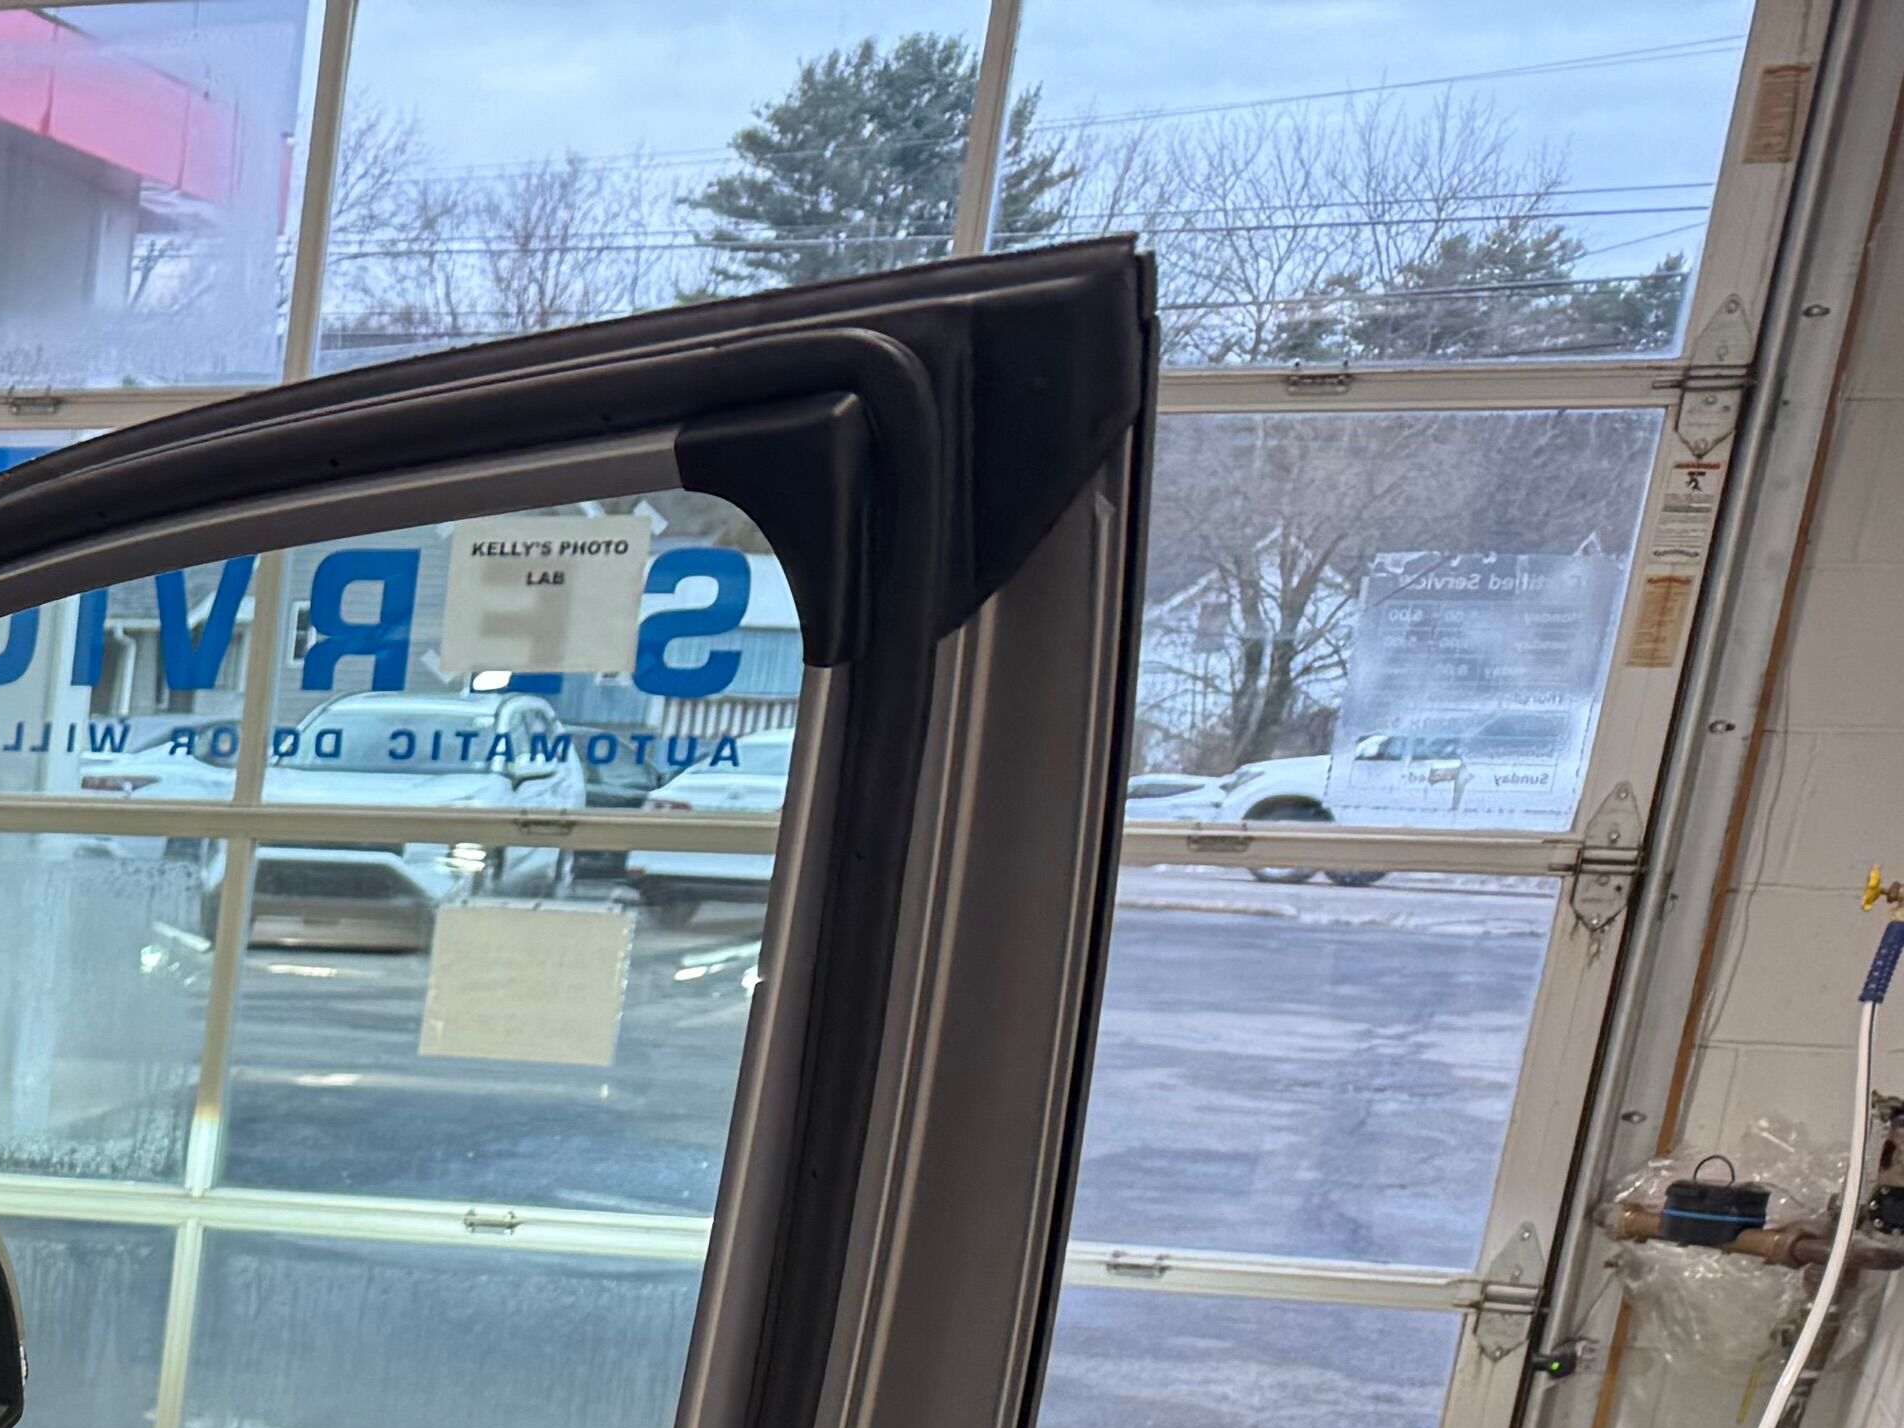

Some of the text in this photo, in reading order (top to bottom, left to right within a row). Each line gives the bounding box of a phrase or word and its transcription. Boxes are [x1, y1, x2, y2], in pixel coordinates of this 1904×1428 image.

[471, 539, 630, 557] KELLY'S PHOTO
[525, 570, 565, 586] LAB
